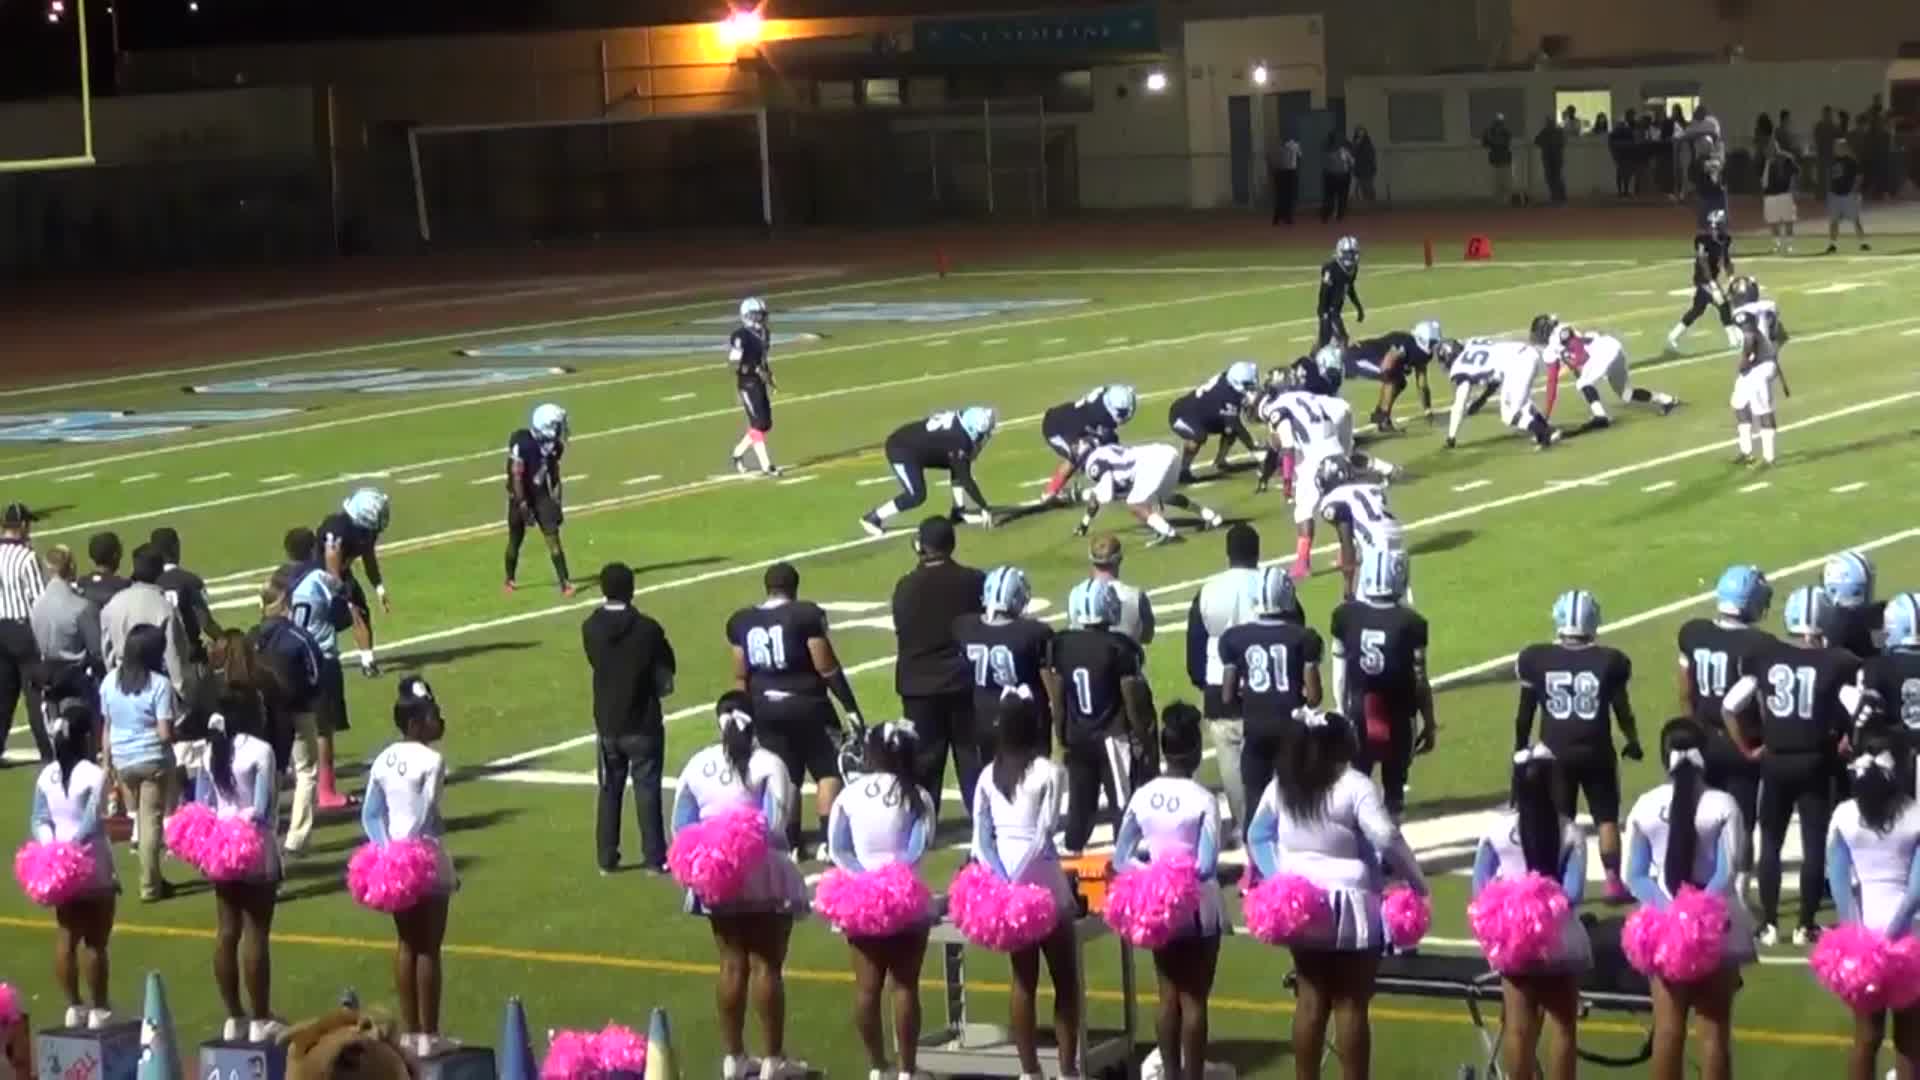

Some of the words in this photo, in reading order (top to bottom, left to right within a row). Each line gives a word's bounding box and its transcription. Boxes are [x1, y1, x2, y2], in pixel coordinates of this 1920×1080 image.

[1468, 238, 1481, 256] G
[747, 624, 785, 669] 61
[966, 644, 1018, 687] 79
[1245, 644, 1289, 692] 81
[1360, 628, 1386, 675] 5
[1073, 667, 1092, 714] 1
[1545, 671, 1600, 720] 58
[1694, 648, 1728, 697] 11
[1767, 663, 1816, 718] 31
